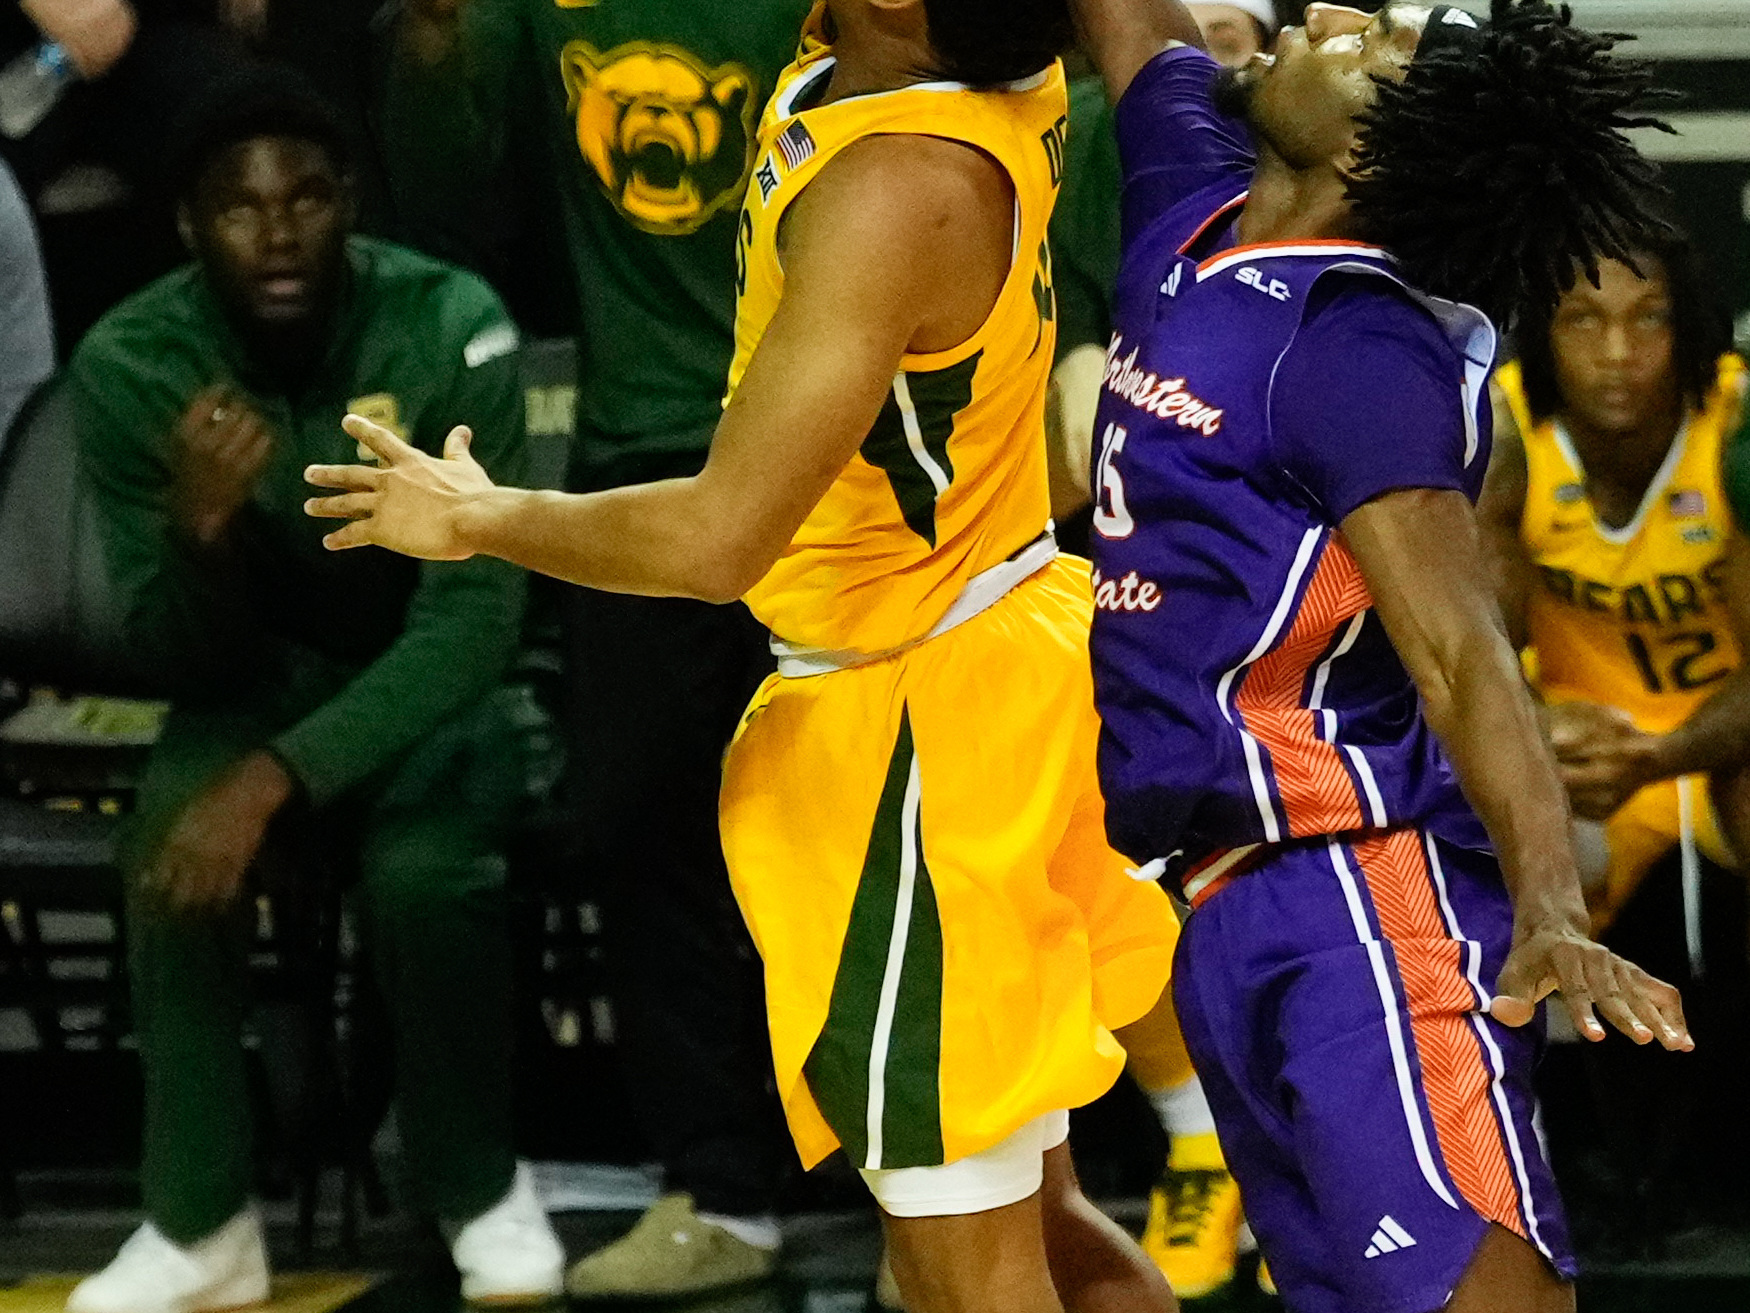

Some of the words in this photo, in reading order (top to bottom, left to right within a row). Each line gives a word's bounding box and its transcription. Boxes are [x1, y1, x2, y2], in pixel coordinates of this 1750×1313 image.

[1234, 266, 1291, 302] SLC
[1092, 421, 1136, 540] 15
[1094, 569, 1162, 612] ate
[1623, 630, 1738, 695] 12
